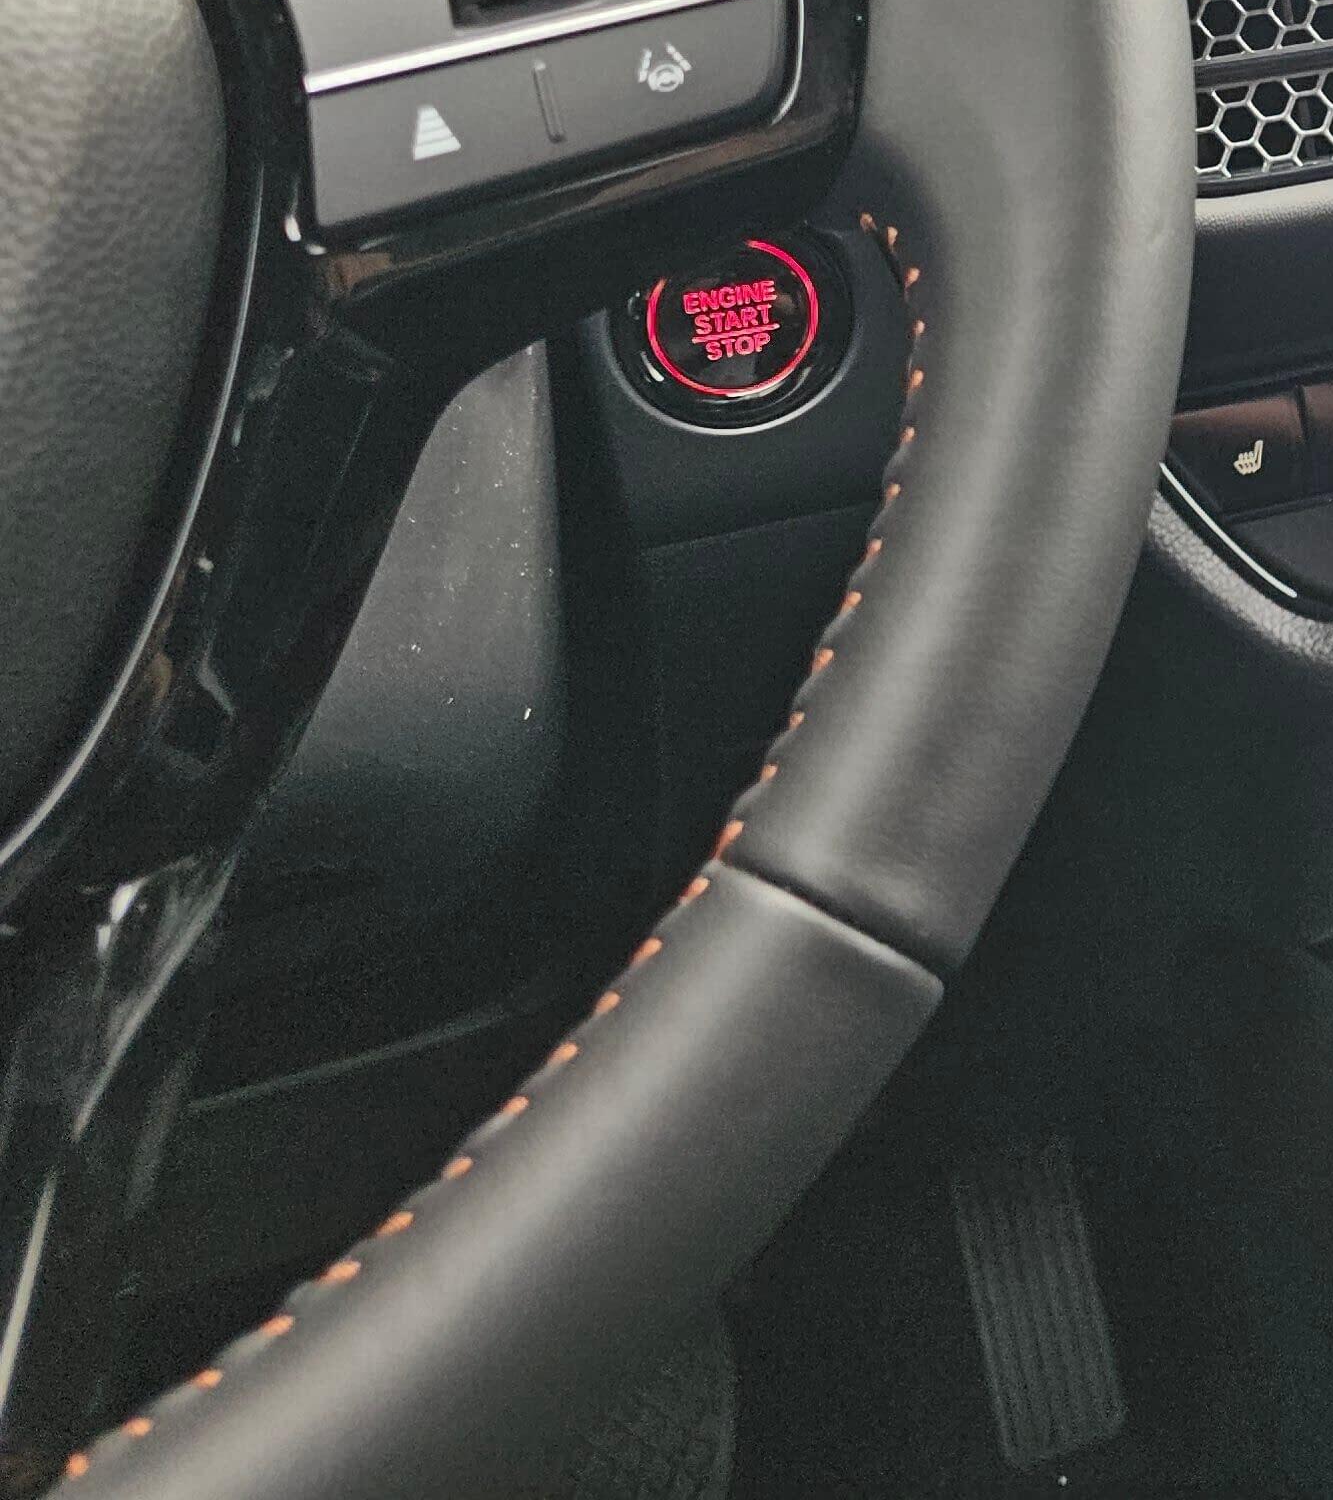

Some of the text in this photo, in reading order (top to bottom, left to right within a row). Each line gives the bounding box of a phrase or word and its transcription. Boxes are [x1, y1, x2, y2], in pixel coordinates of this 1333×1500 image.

[683, 280, 777, 315] ENGINE
[694, 304, 772, 335] START
[705, 332, 771, 361] STOP
